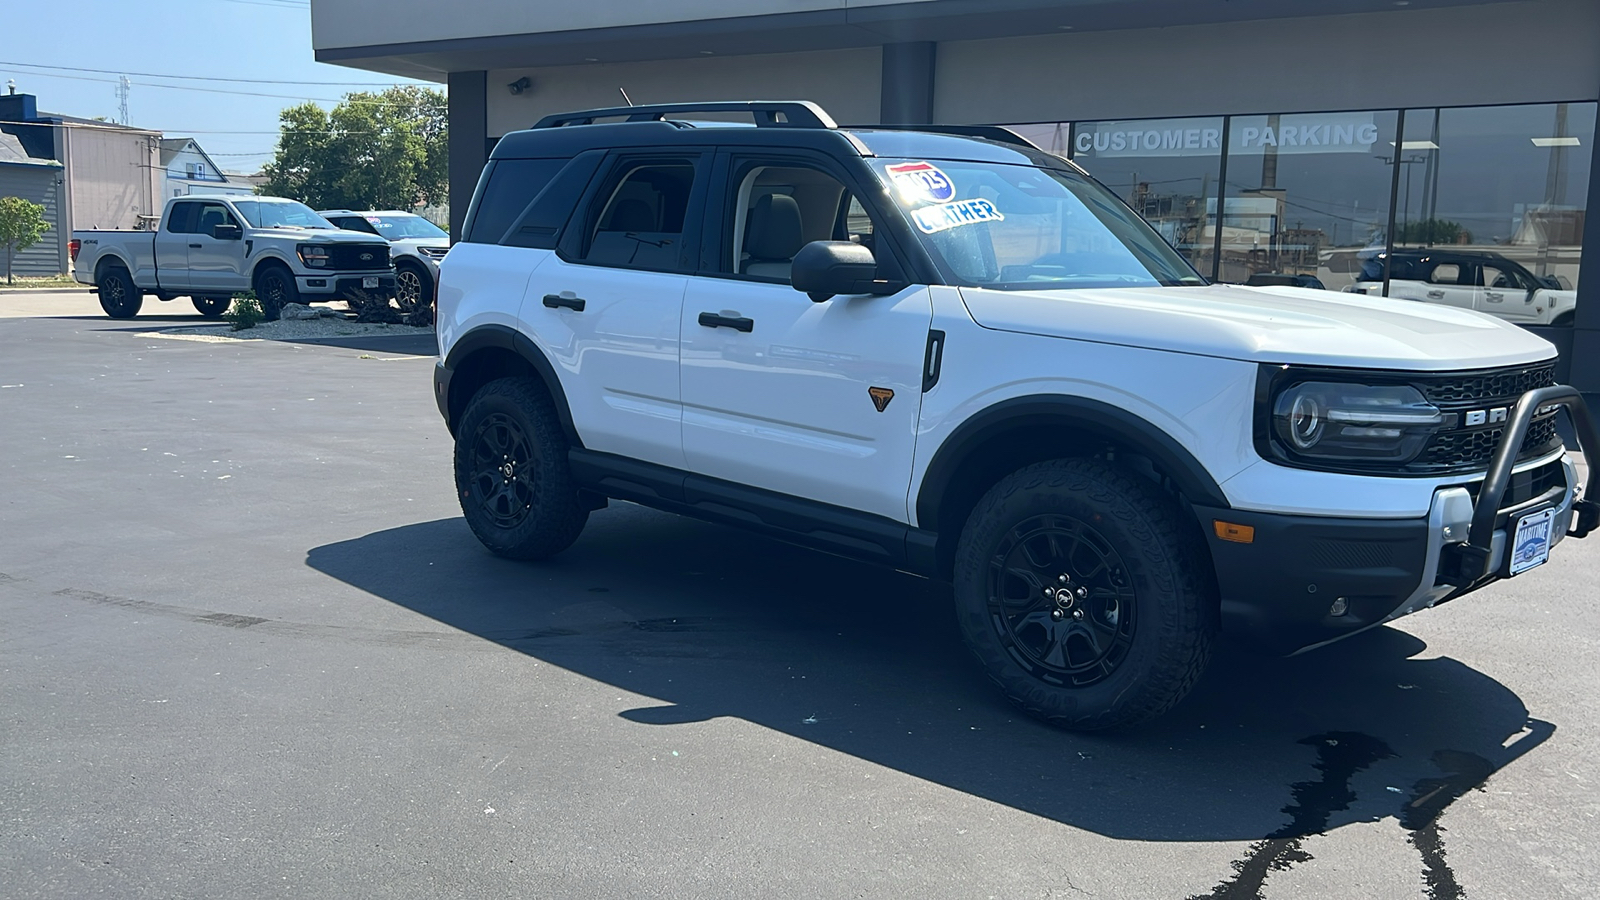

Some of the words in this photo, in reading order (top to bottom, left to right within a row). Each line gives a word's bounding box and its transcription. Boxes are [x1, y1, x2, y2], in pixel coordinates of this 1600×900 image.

[1076, 129, 1220, 152] CUSTOMER
[1241, 123, 1378, 147] PARKING
[895, 170, 947, 193] 25
[1516, 521, 1548, 550] MARITIME
